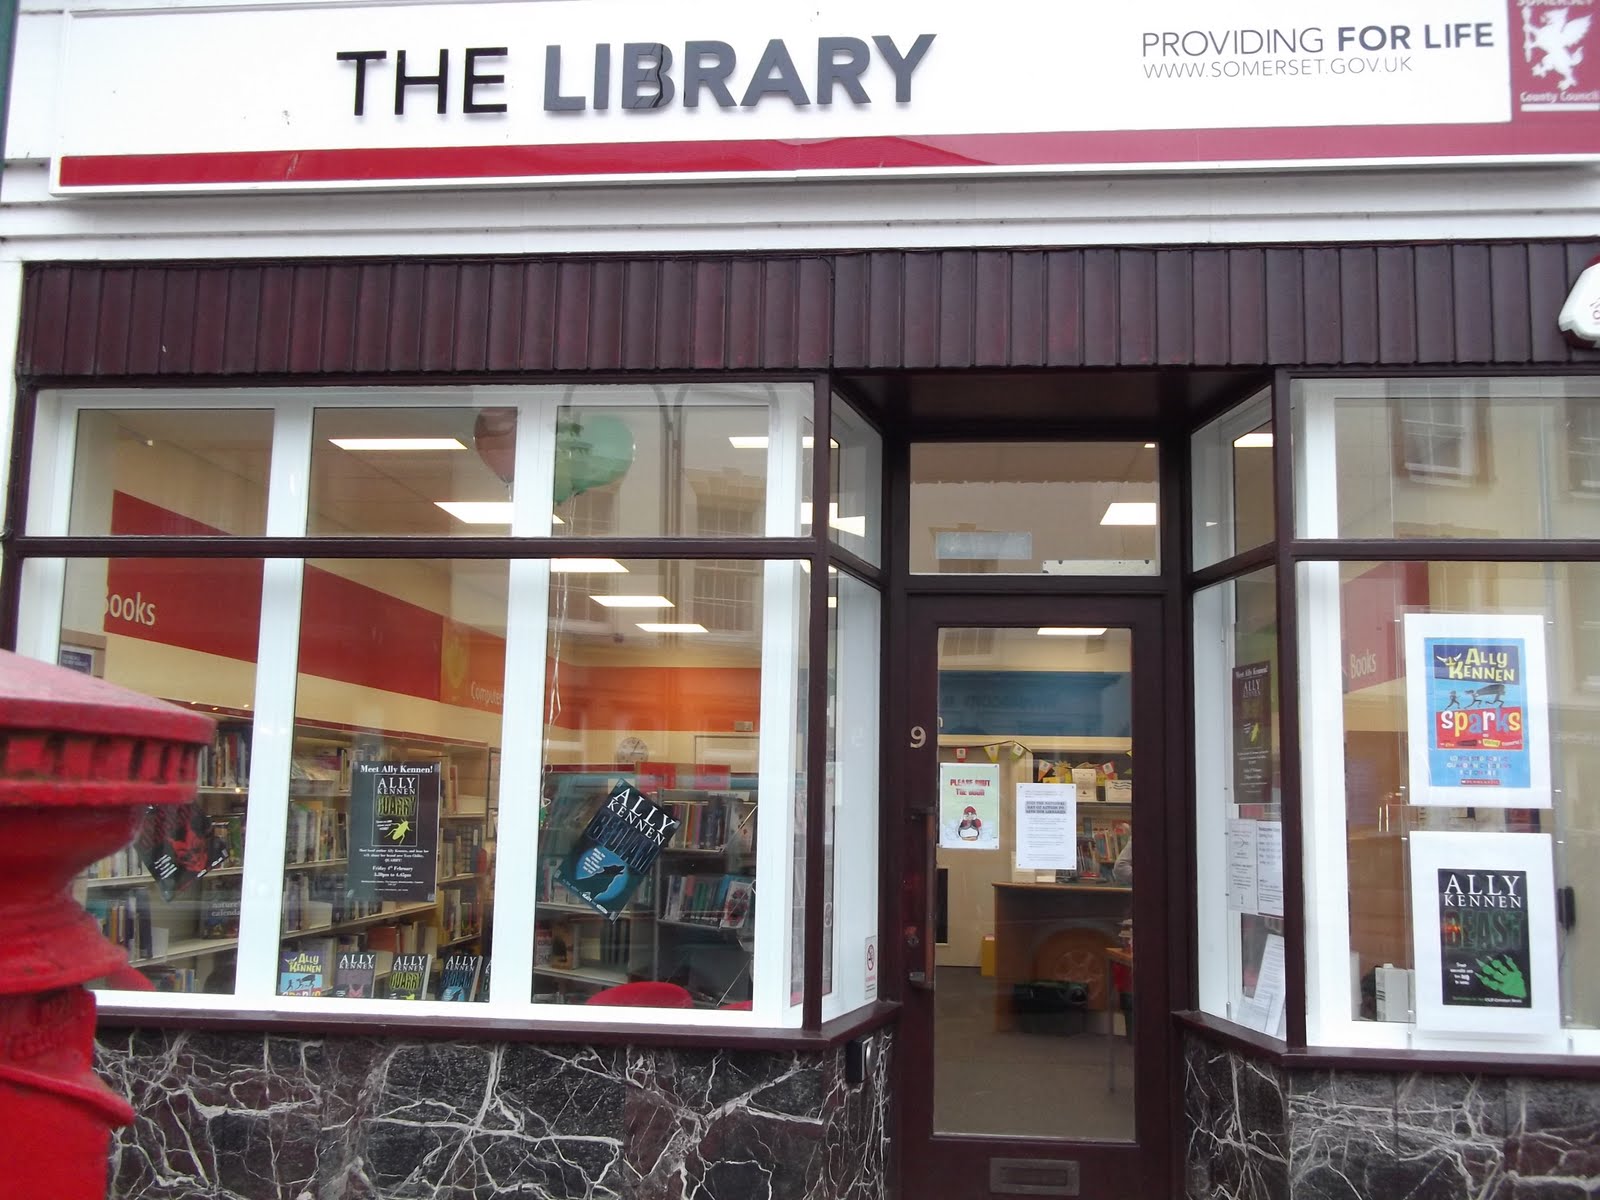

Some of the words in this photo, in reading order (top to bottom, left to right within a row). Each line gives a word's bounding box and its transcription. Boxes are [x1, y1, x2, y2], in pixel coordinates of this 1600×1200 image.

[1142, 27, 1325, 57] PROVIDING
[1337, 25, 1411, 52] FOR
[1424, 22, 1495, 50] LIFE
[336, 46, 508, 116] THE
[543, 34, 937, 112] LIBRARY
[1143, 56, 1413, 80] WWW.SOMERSET.GOV.UK
[1350, 651, 1377, 680] Books
[1449, 660, 1515, 682] KENNEN
[1441, 707, 1521, 737] sparks
[910, 726, 927, 749] 9
[360, 764, 379, 773] Meet
[381, 765, 399, 775] Ally
[400, 765, 433, 773] Kennen!
[378, 777, 416, 789] ALLY
[613, 787, 676, 836] ALLY
[606, 799, 666, 847] KENNEN
[1444, 874, 1520, 896] ALLY
[1444, 895, 1522, 909] KENNEN
[1443, 909, 1524, 950] BEAST
[289, 961, 322, 973] KENNEN
[340, 954, 375, 965] ALLY
[393, 955, 426, 967] ALLY
[445, 955, 477, 970] ALLY
